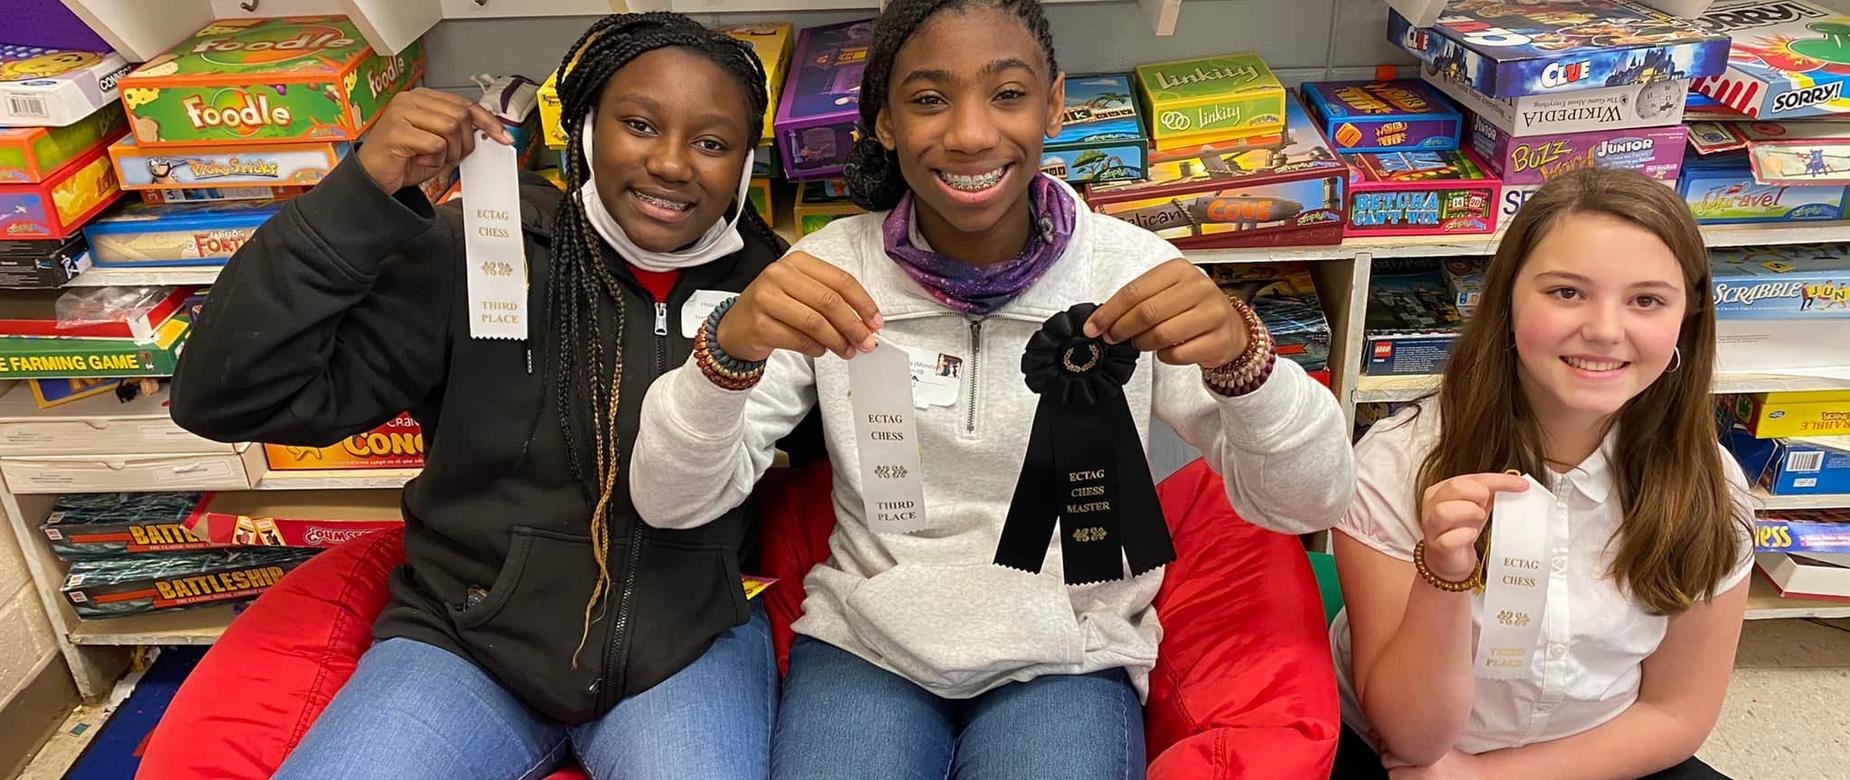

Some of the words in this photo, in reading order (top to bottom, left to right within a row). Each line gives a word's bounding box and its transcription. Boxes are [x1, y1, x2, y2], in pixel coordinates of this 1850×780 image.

[192, 32, 355, 52] Foodle
[367, 56, 405, 100] Foodle
[1541, 60, 1591, 88] CLUE
[1774, 83, 1841, 111] SORRY!
[183, 93, 292, 129] Foodle
[1523, 105, 1622, 128] WIKIPEDIA
[1596, 139, 1653, 158] JUNIOR
[1354, 192, 1438, 210] BETCHA
[477, 209, 509, 220] ECTAG
[1406, 211, 1439, 225] WIN
[478, 227, 509, 238] CHESS
[1713, 281, 1802, 305] SCRABBLE
[482, 302, 518, 311] THIRD
[481, 314, 519, 324] PLACE
[9, 356, 87, 371] FARMING
[88, 354, 140, 369] GAME
[868, 414, 904, 424] ECTAG
[871, 431, 904, 441] CHESS
[1069, 469, 1105, 482] ECTAG
[1071, 485, 1105, 498] CHESS
[876, 500, 914, 510] THIRD
[1066, 501, 1111, 514] MASTER
[877, 511, 916, 521] PLACE
[1504, 557, 1539, 570] ECTAG
[155, 566, 284, 600] BATTLESHIP
[1502, 575, 1536, 587] CHESS
